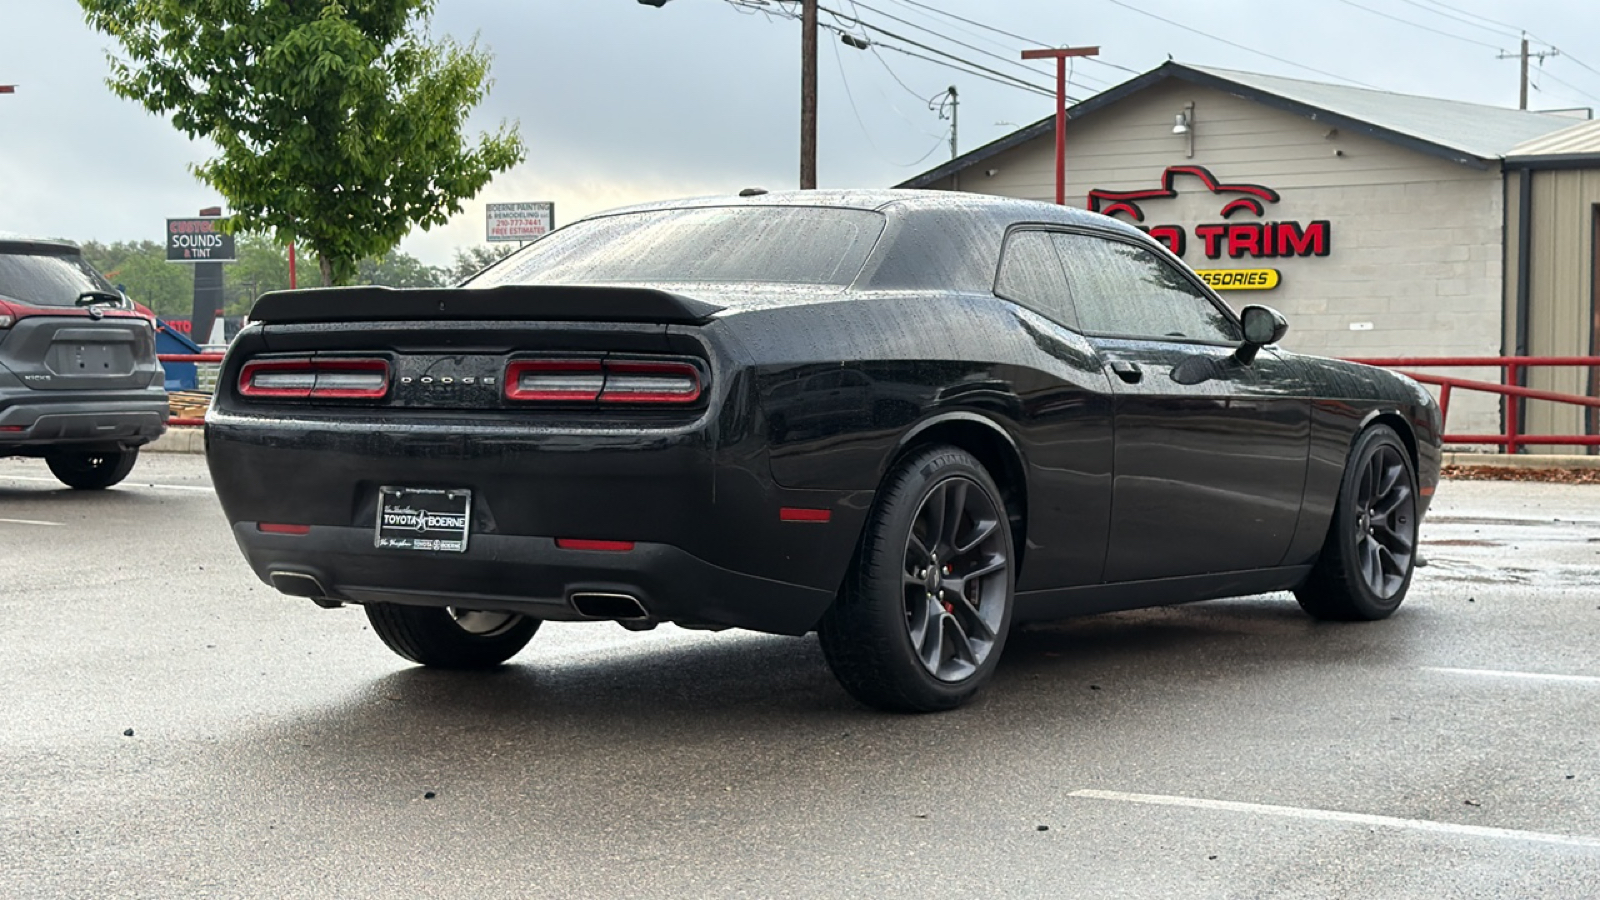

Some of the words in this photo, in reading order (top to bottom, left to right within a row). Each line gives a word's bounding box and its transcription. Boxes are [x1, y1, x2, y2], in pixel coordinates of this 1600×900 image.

[517, 203, 550, 211] PAINTING
[492, 227, 509, 235] FREE
[509, 226, 545, 235] ESTIMATES
[172, 234, 222, 248] SOUNDS
[1195, 220, 1331, 259] TRIM
[191, 248, 211, 258] TINT
[401, 376, 495, 385] DODGE
[384, 515, 416, 525] TOYOTA
[428, 516, 466, 527] BOERNE
